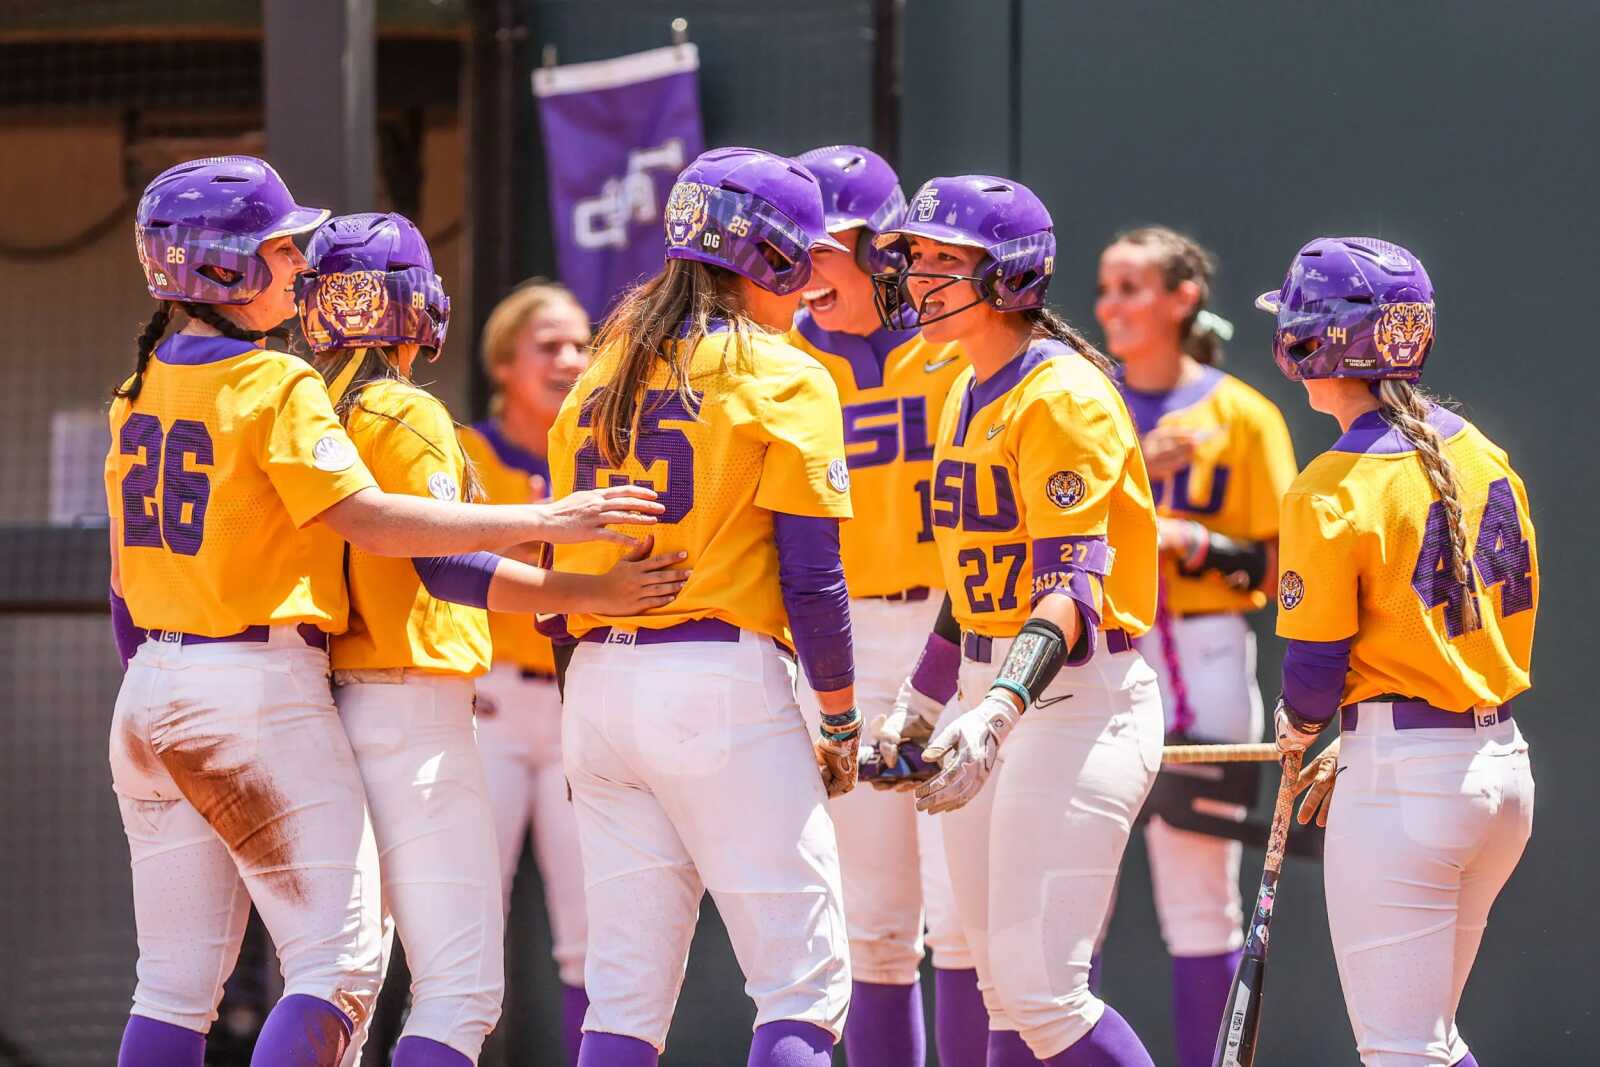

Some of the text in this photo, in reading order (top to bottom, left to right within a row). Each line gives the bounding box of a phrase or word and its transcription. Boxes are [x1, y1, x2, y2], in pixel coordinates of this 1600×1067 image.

[727, 215, 752, 238] 25
[703, 231, 720, 248] DG
[166, 246, 185, 264] 26
[1327, 326, 1347, 345] 44
[120, 412, 214, 557] 26
[933, 459, 1019, 532] SU
[1060, 543, 1088, 563] 27
[1410, 477, 1533, 640] 44
[958, 543, 1027, 613] 27
[162, 630, 181, 643] LSU
[608, 633, 633, 645] LSU
[1477, 713, 1496, 727] LSU
